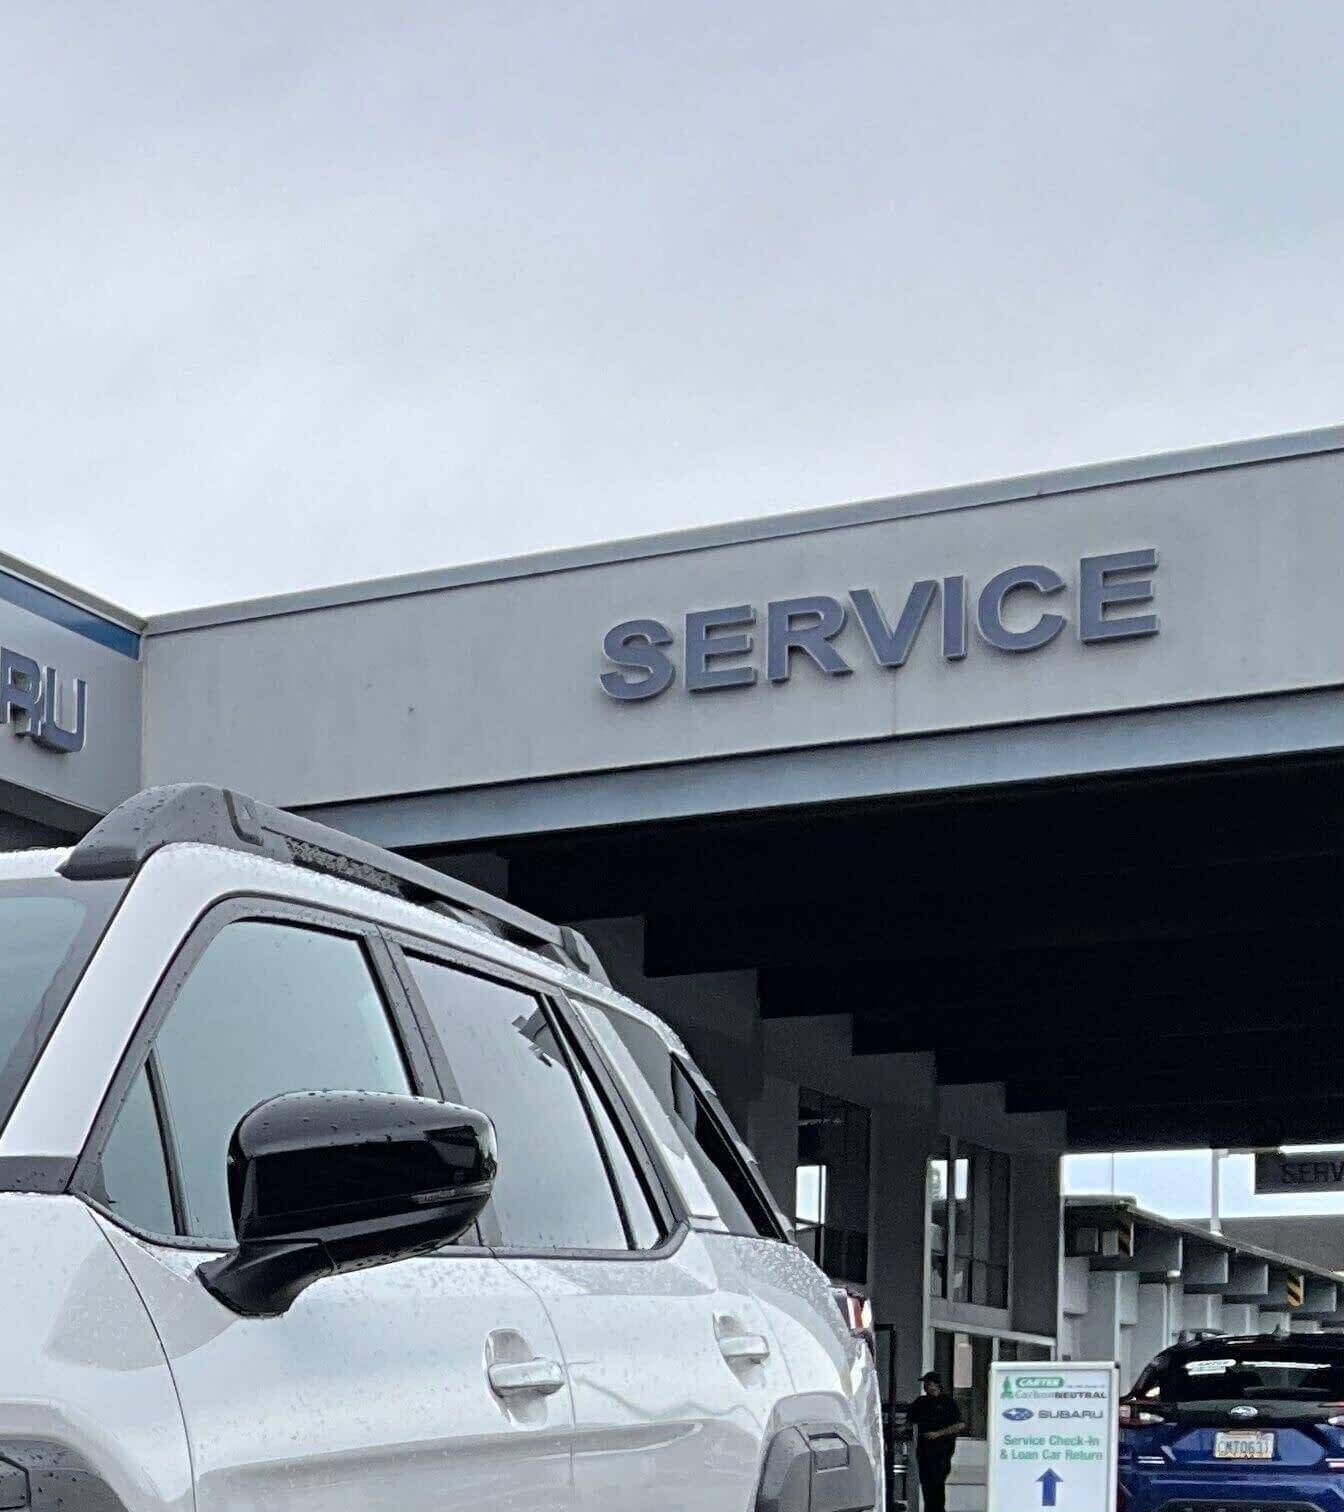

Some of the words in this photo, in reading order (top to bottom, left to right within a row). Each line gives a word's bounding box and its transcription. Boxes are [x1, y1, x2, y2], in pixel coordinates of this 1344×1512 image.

[599, 548, 1160, 701] SERVICE
[1018, 1377, 1062, 1387] CARTER
[1038, 1410, 1104, 1419] SUBARU
[1003, 1435, 1046, 1445] Service
[1000, 1449, 1008, 1459] &
[1012, 1449, 1039, 1459] Loan
[1042, 1449, 1061, 1460] Car
[1065, 1449, 1103, 1460] Return
